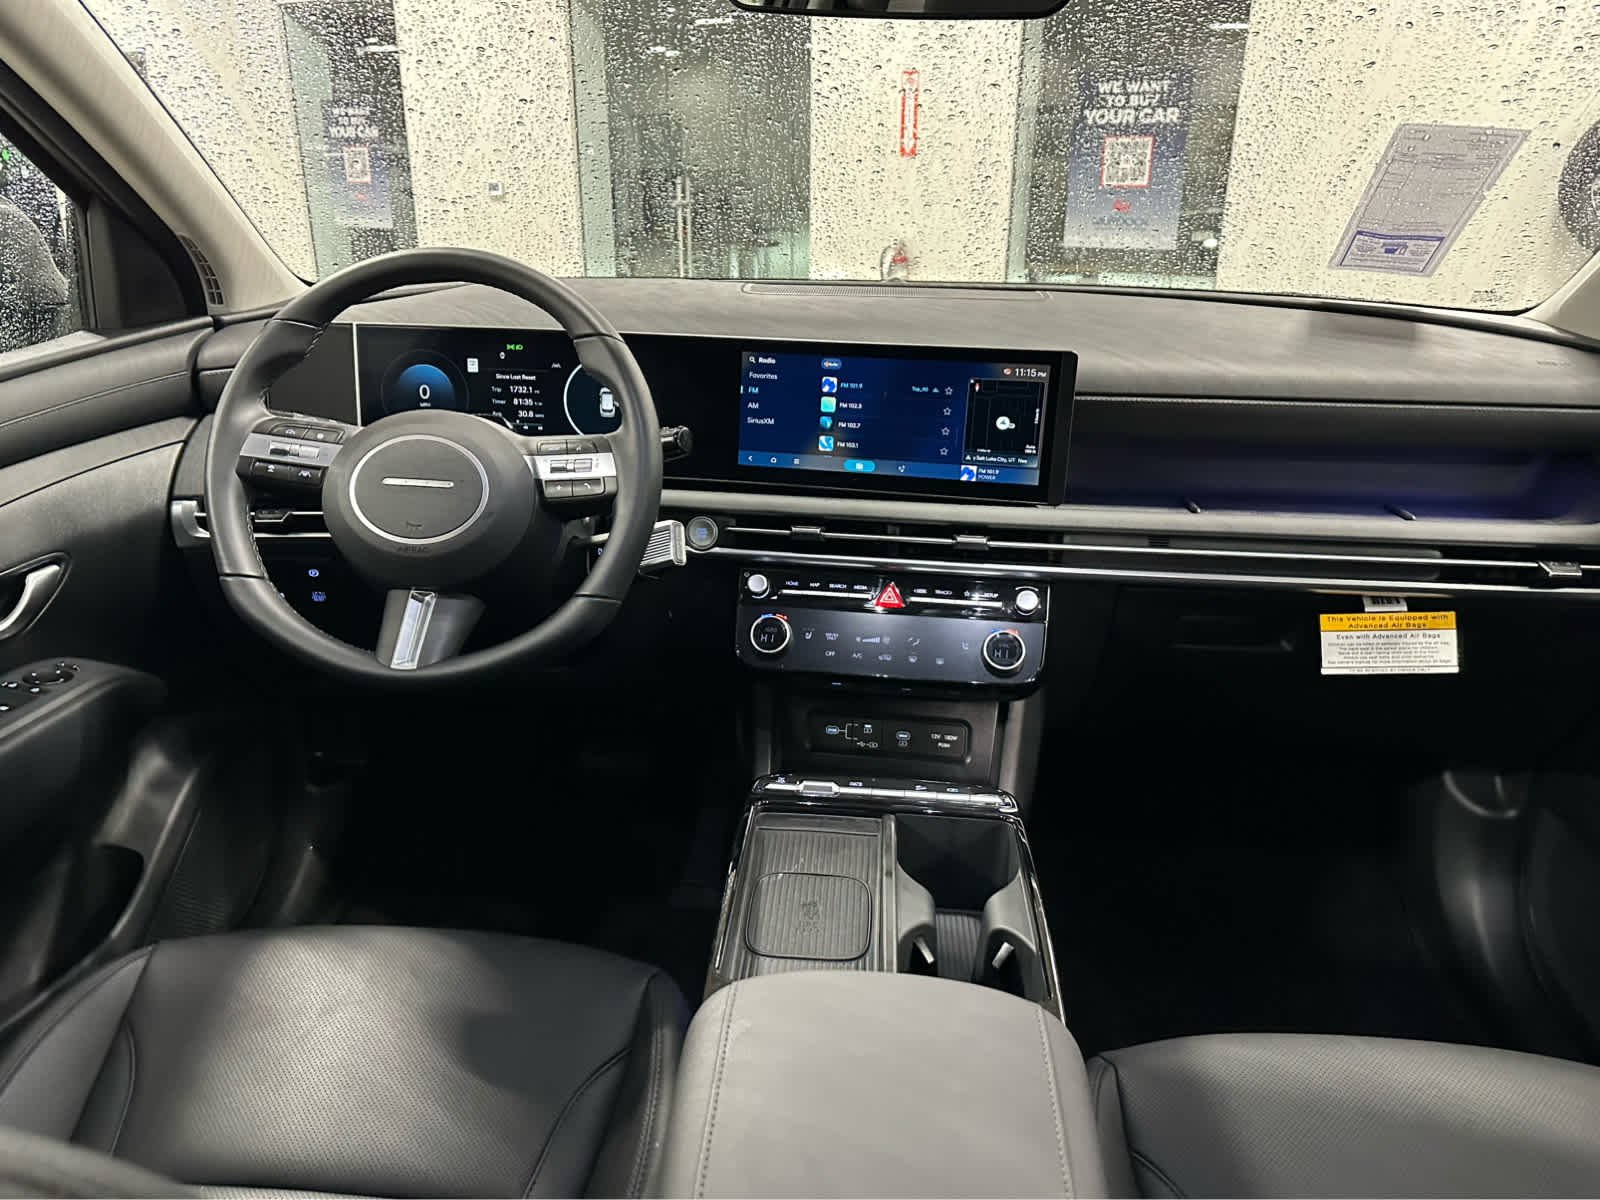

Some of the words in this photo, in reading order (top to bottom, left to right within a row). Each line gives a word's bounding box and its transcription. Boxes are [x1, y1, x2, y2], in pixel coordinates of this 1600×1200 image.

[1099, 80, 1123, 93] WE
[1127, 80, 1171, 93] WANT
[1106, 94, 1125, 107] TO
[1129, 94, 1160, 107] BUY
[1084, 108, 1136, 124] YOUR
[1139, 107, 1181, 124] CAR
[758, 356, 777, 365] Radio
[749, 371, 778, 380] Favorites
[1014, 367, 1037, 377] 11:15
[419, 384, 431, 400] 0
[510, 385, 533, 394] 1732.1
[748, 386, 759, 394] FM
[747, 401, 760, 409] AM
[747, 416, 775, 425] SiriusXM
[1389, 614, 1428, 622] Equipped
[1422, 632, 1441, 640] Bags
